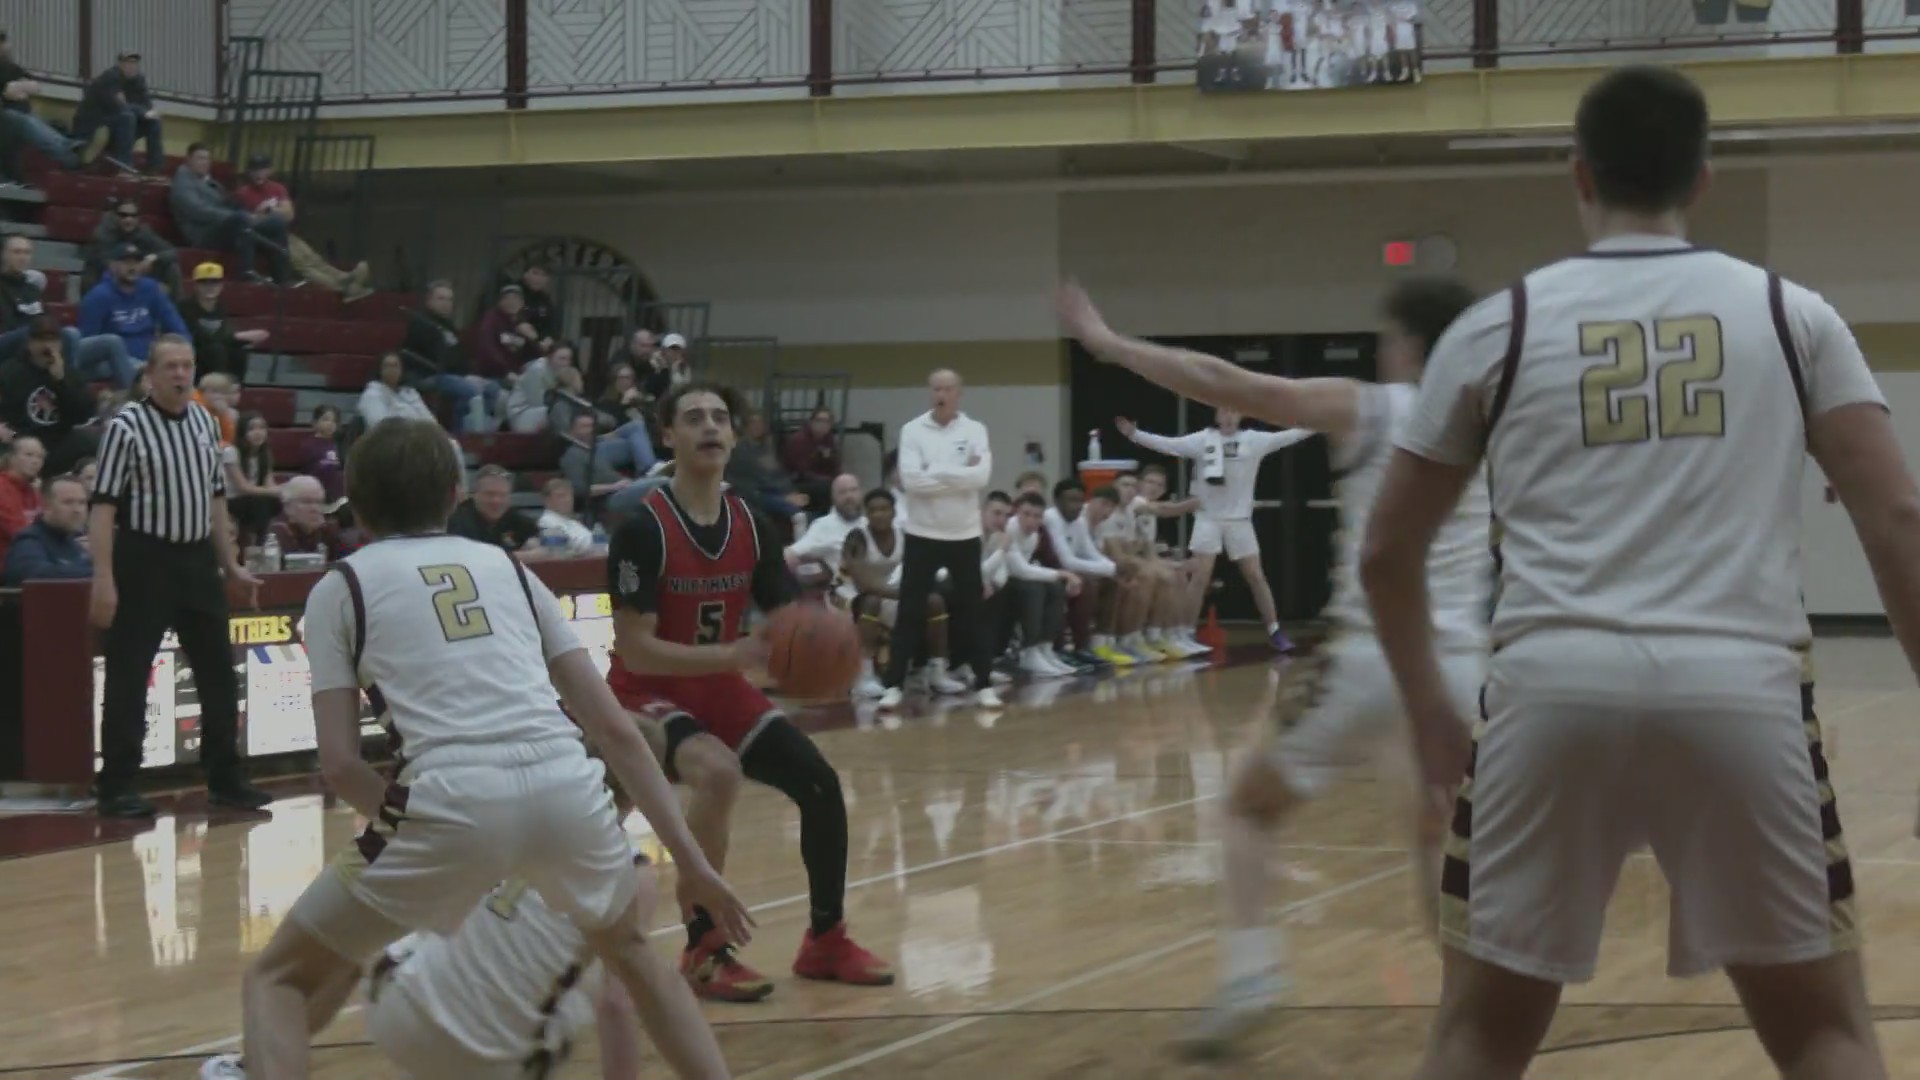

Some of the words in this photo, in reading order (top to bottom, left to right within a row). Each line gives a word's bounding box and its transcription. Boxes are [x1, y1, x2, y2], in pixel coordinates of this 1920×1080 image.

[1578, 313, 1725, 447] 22
[417, 563, 494, 643] 2
[694, 600, 726, 646] 5
